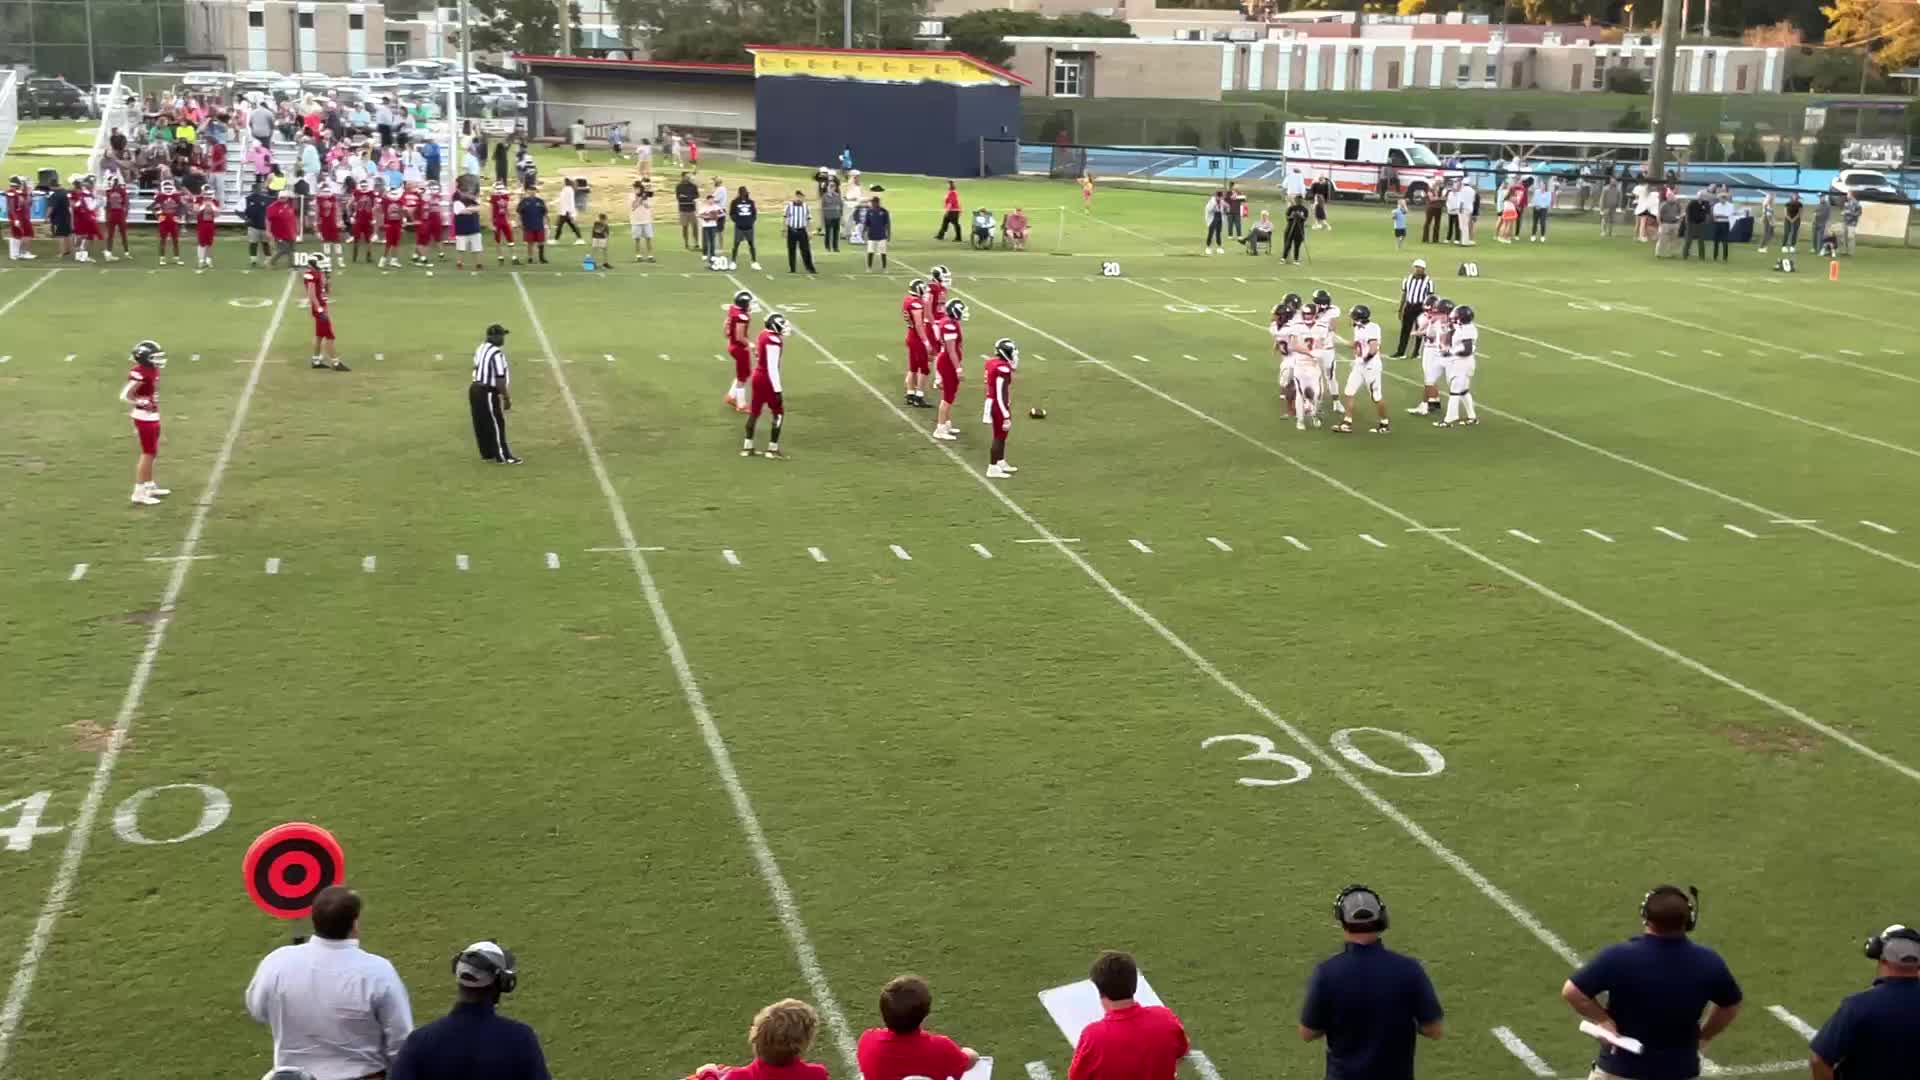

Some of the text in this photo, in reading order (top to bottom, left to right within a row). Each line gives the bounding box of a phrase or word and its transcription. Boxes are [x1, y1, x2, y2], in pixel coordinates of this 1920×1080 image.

[711, 256, 728, 270] 30
[1103, 262, 1120, 276] 20
[1464, 263, 1478, 276] 10
